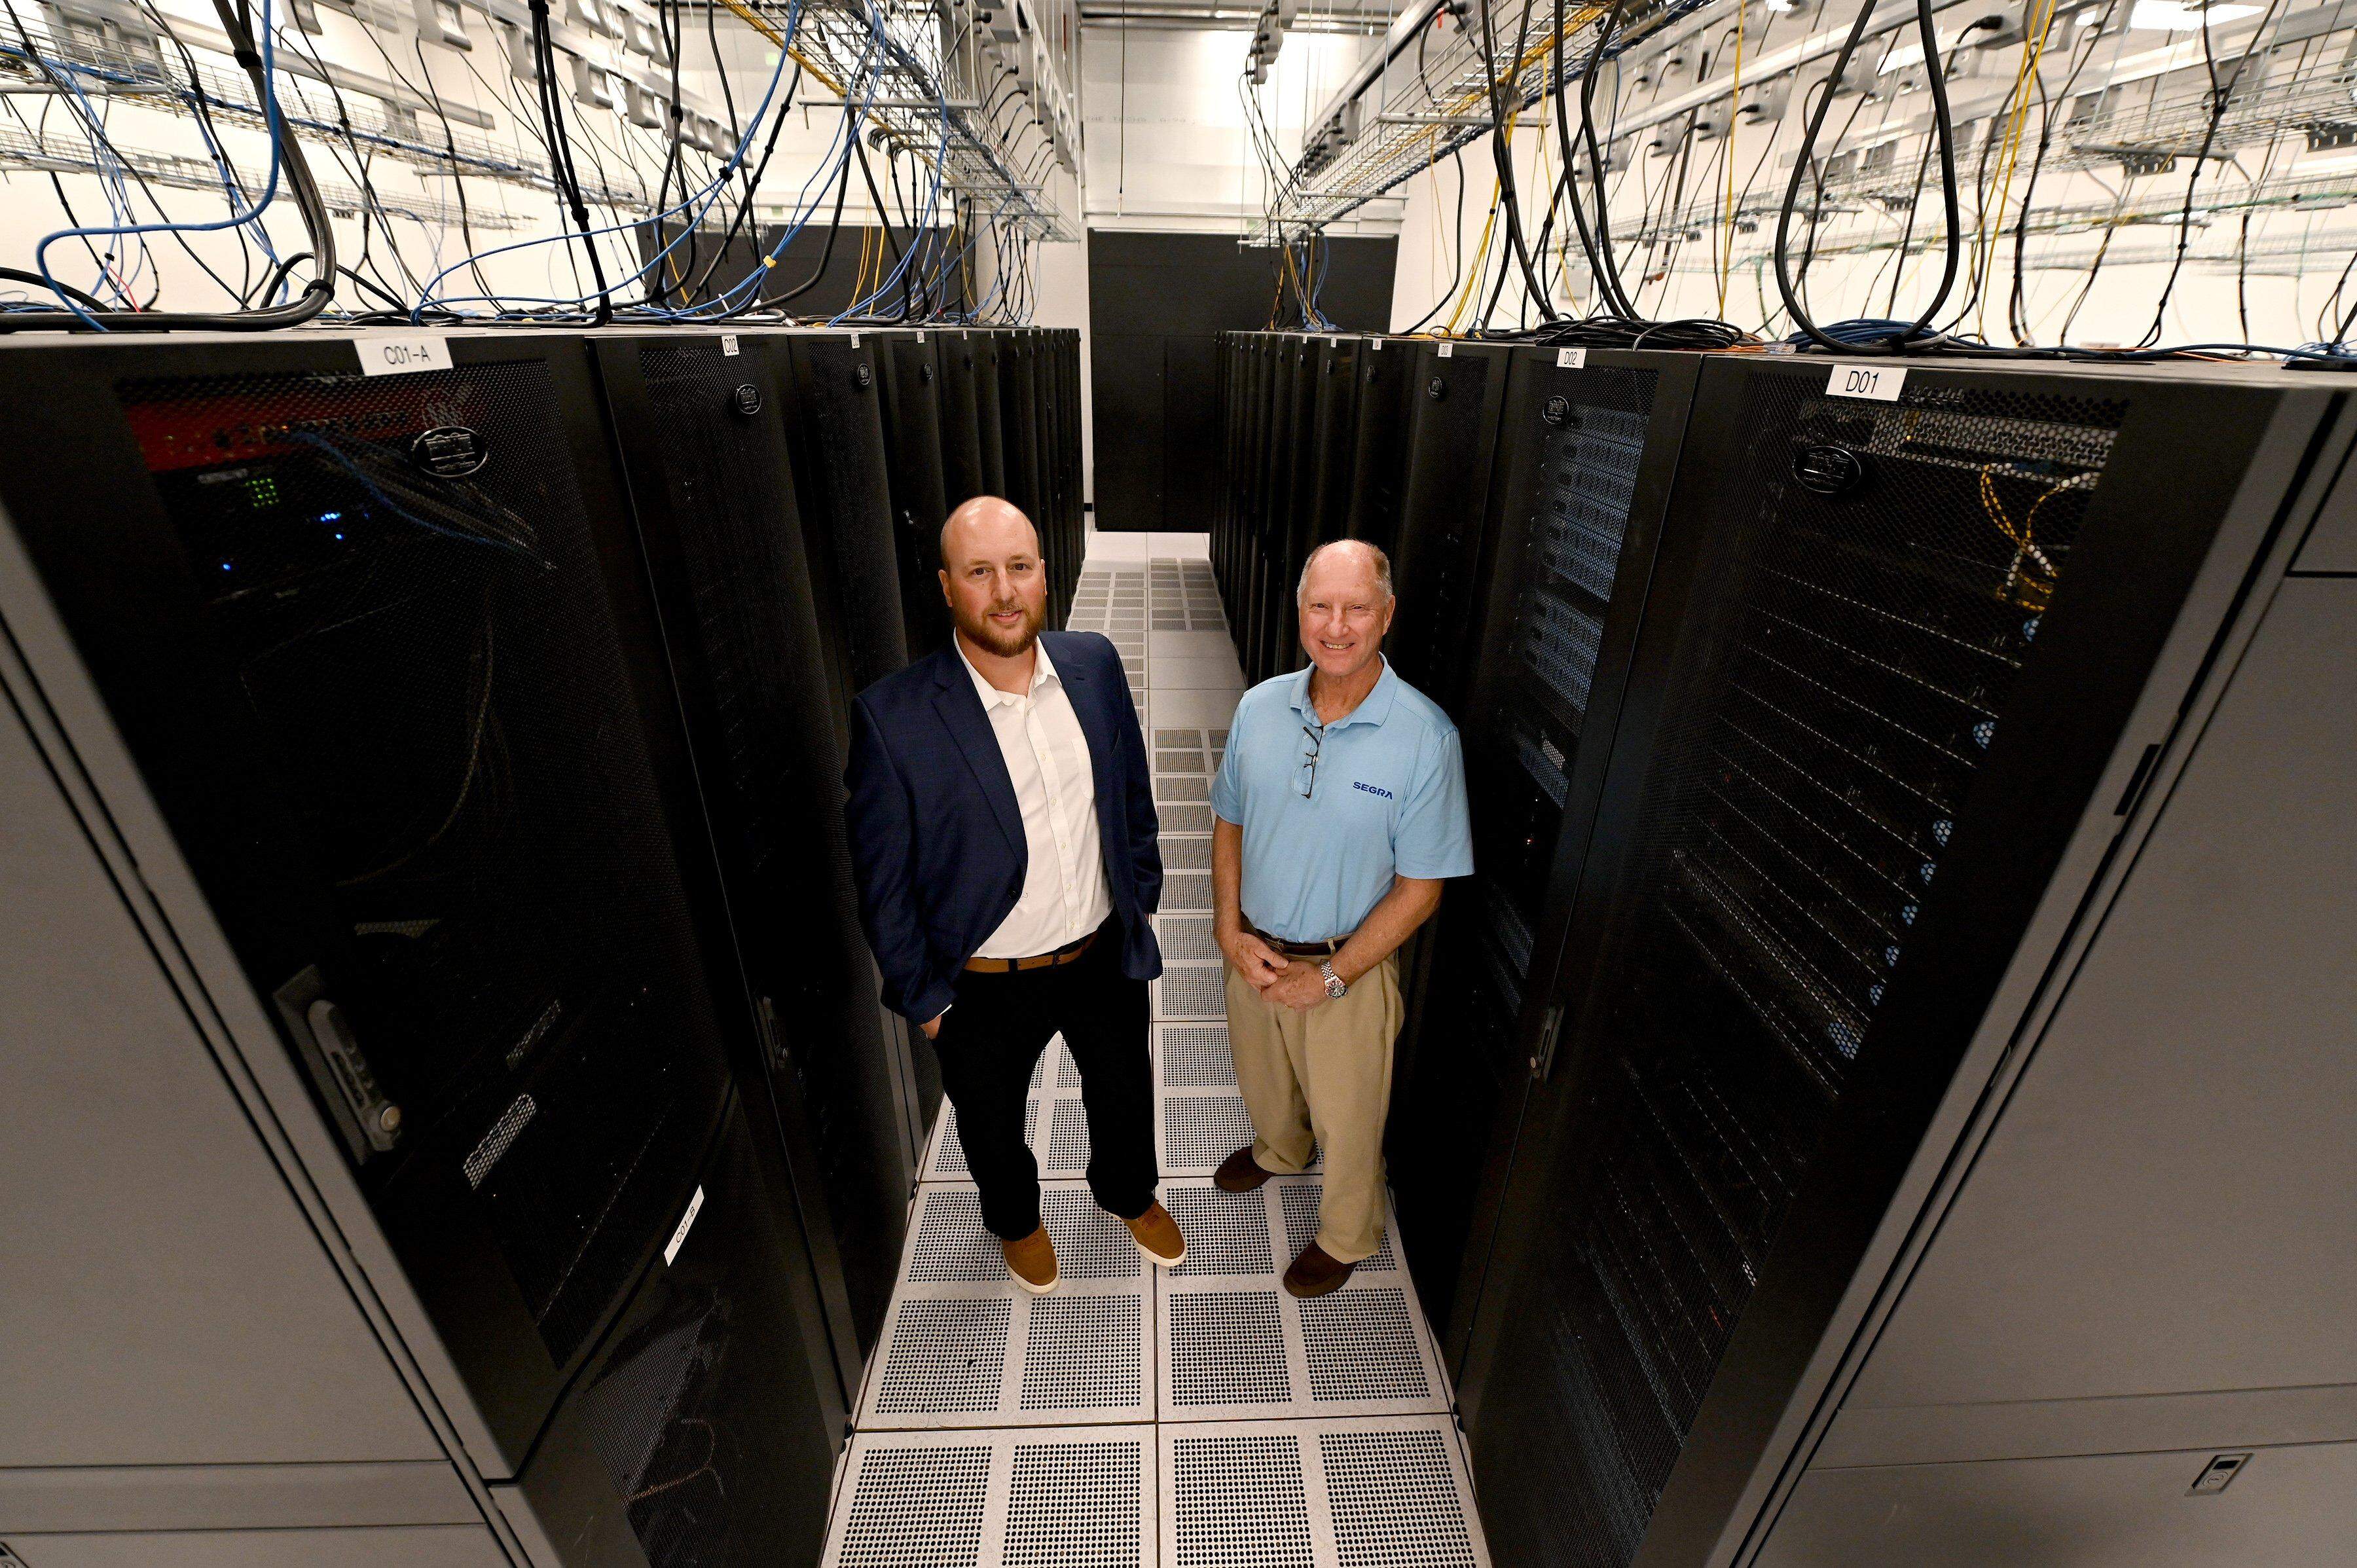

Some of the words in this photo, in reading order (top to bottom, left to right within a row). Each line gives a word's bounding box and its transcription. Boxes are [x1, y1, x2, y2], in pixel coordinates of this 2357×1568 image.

[384, 345, 431, 365] C01-A
[724, 338, 737, 353] C02
[1564, 352, 1577, 365] D02
[1846, 371, 1880, 394] D01
[1353, 781, 1393, 800] SEGRA
[676, 1206, 695, 1243] C01-B
